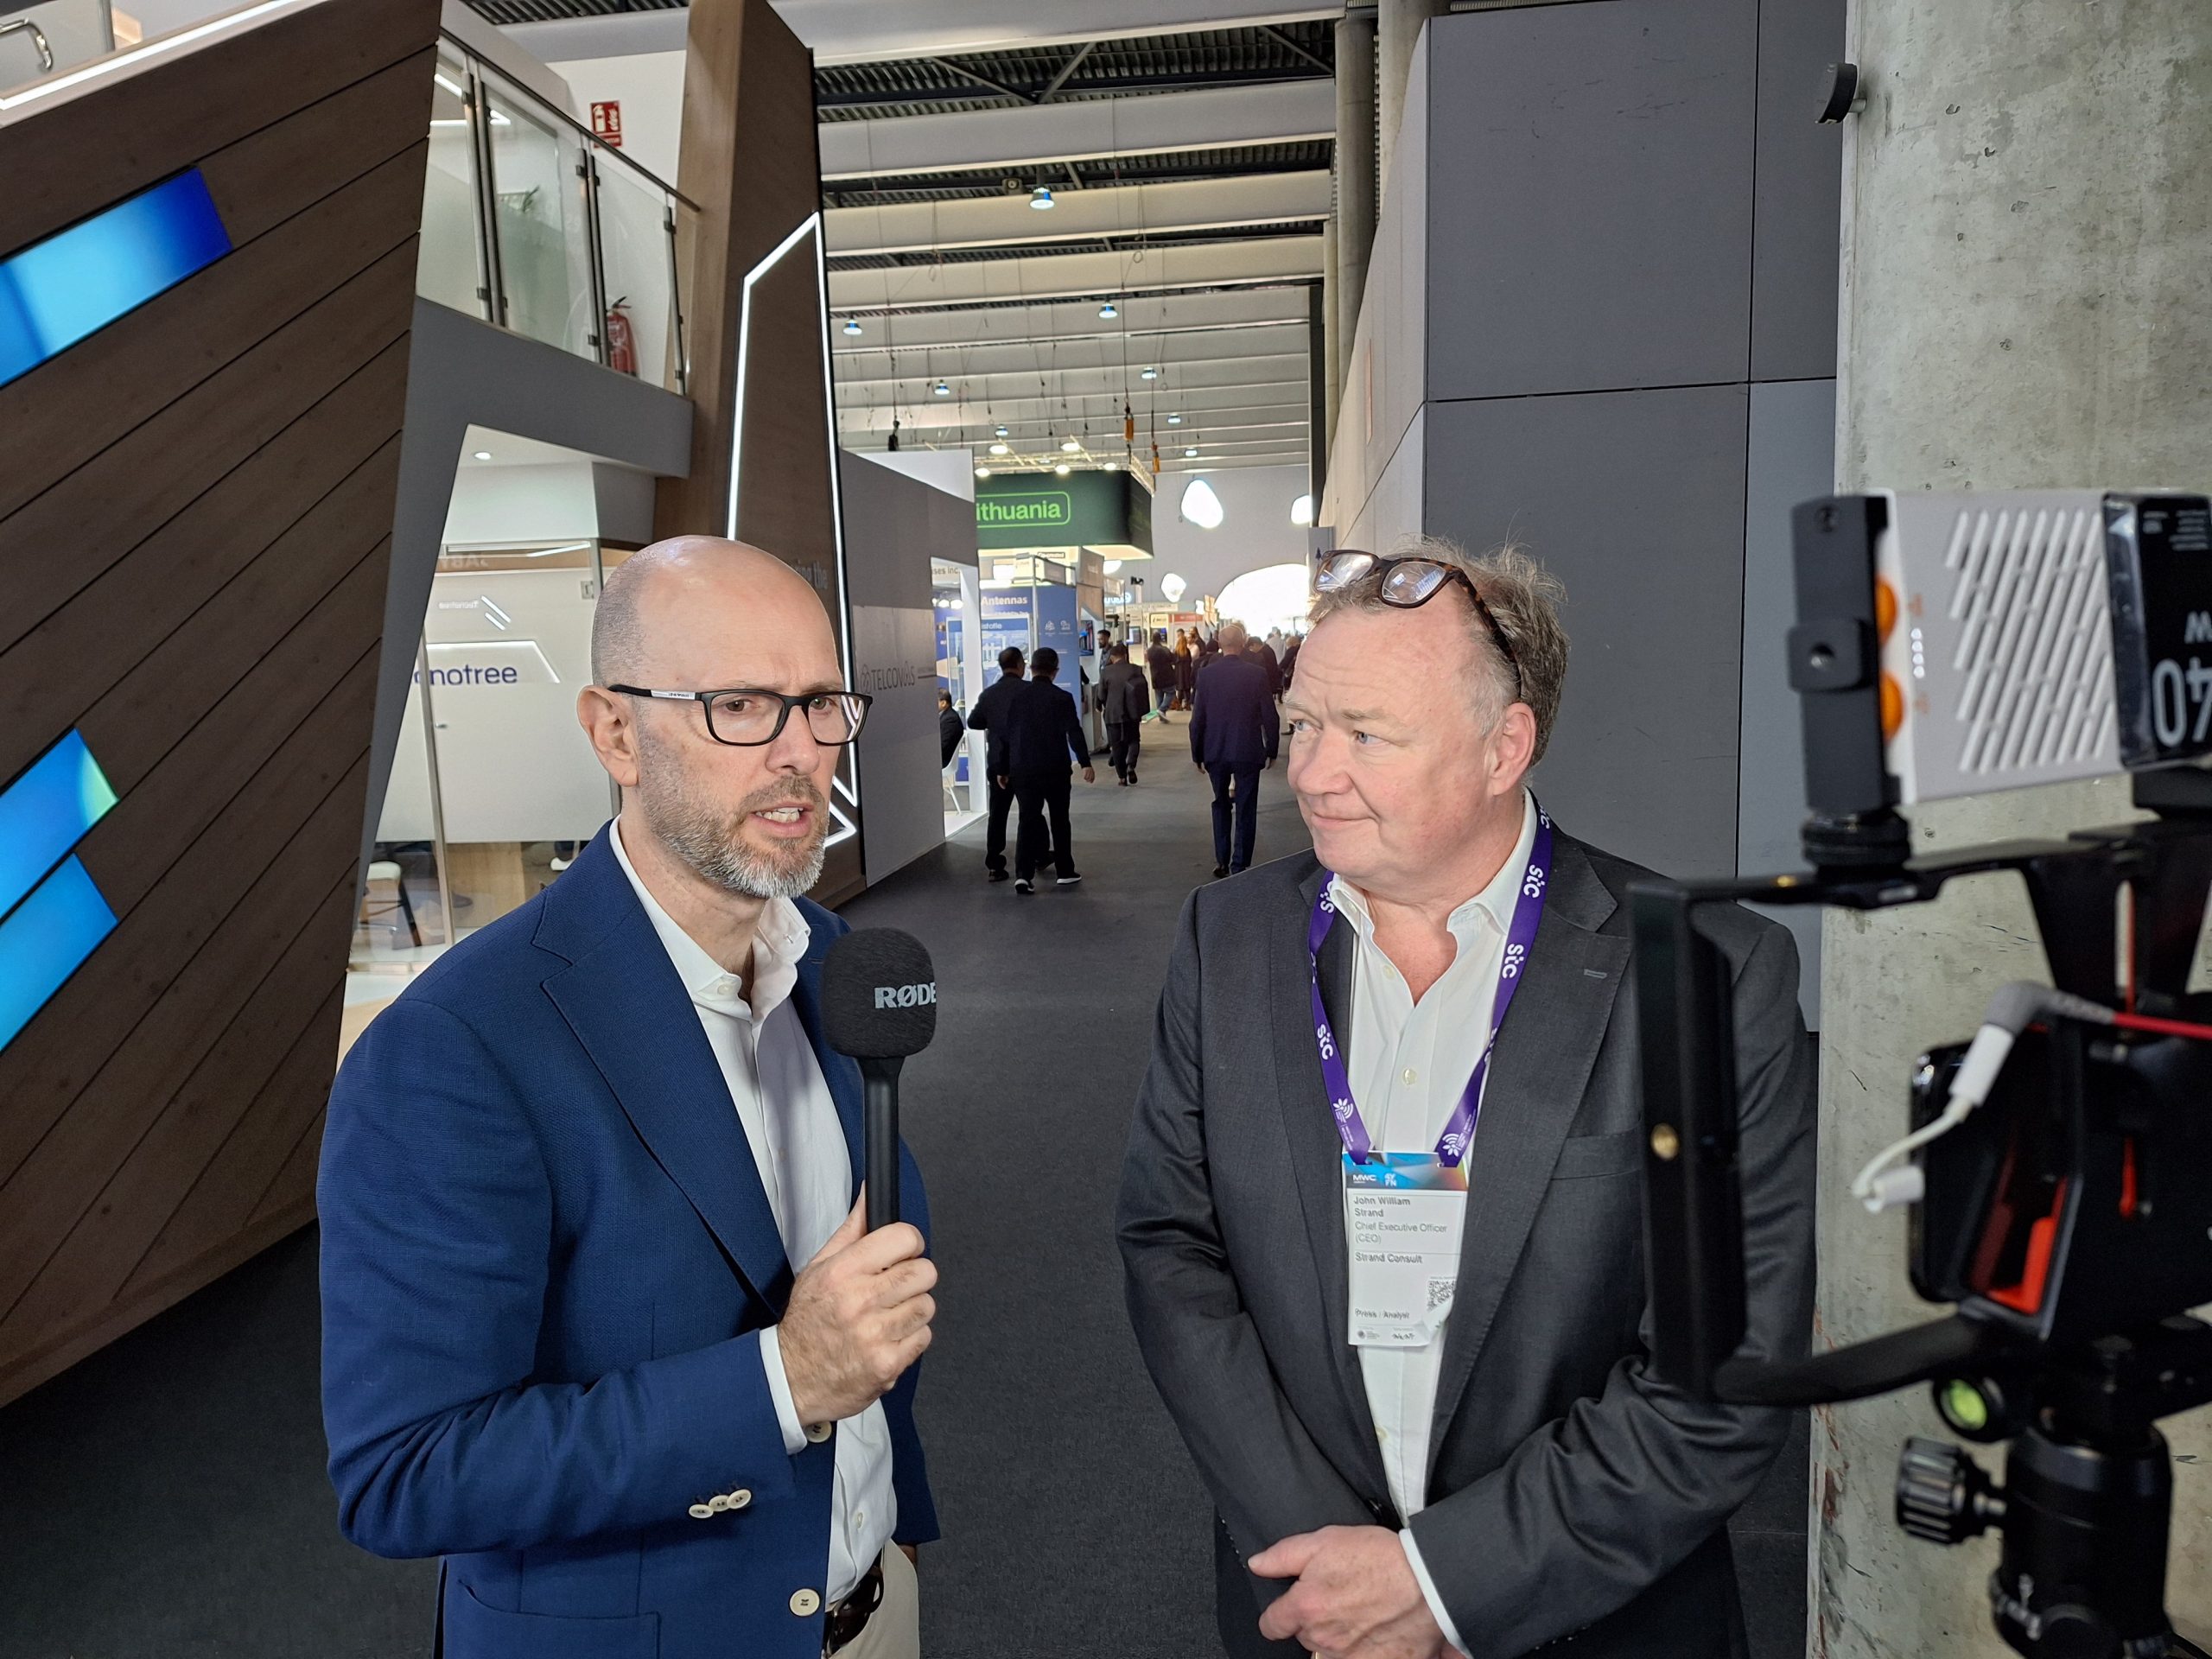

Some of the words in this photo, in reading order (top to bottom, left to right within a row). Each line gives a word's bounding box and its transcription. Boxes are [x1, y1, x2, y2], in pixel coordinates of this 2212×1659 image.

[976, 499, 1061, 521] ithuania
[981, 595, 1028, 606] Antennas
[1522, 864, 1545, 899] stc
[1502, 944, 1524, 979] stc
[874, 982, 937, 1009] RØDE
[1317, 1024, 1333, 1060] stc
[1353, 1196, 1376, 1205] John
[1378, 1197, 1411, 1205] William
[1354, 1208, 1384, 1217] Strand
[1355, 1221, 1376, 1230] Chief
[1378, 1222, 1418, 1232] Executive
[1420, 1224, 1447, 1233] Officer
[1355, 1233, 1382, 1244] (CEO)
[1355, 1252, 1385, 1262] Strand
[1387, 1254, 1423, 1263] Consult
[1382, 1309, 1410, 1320] Analyst
